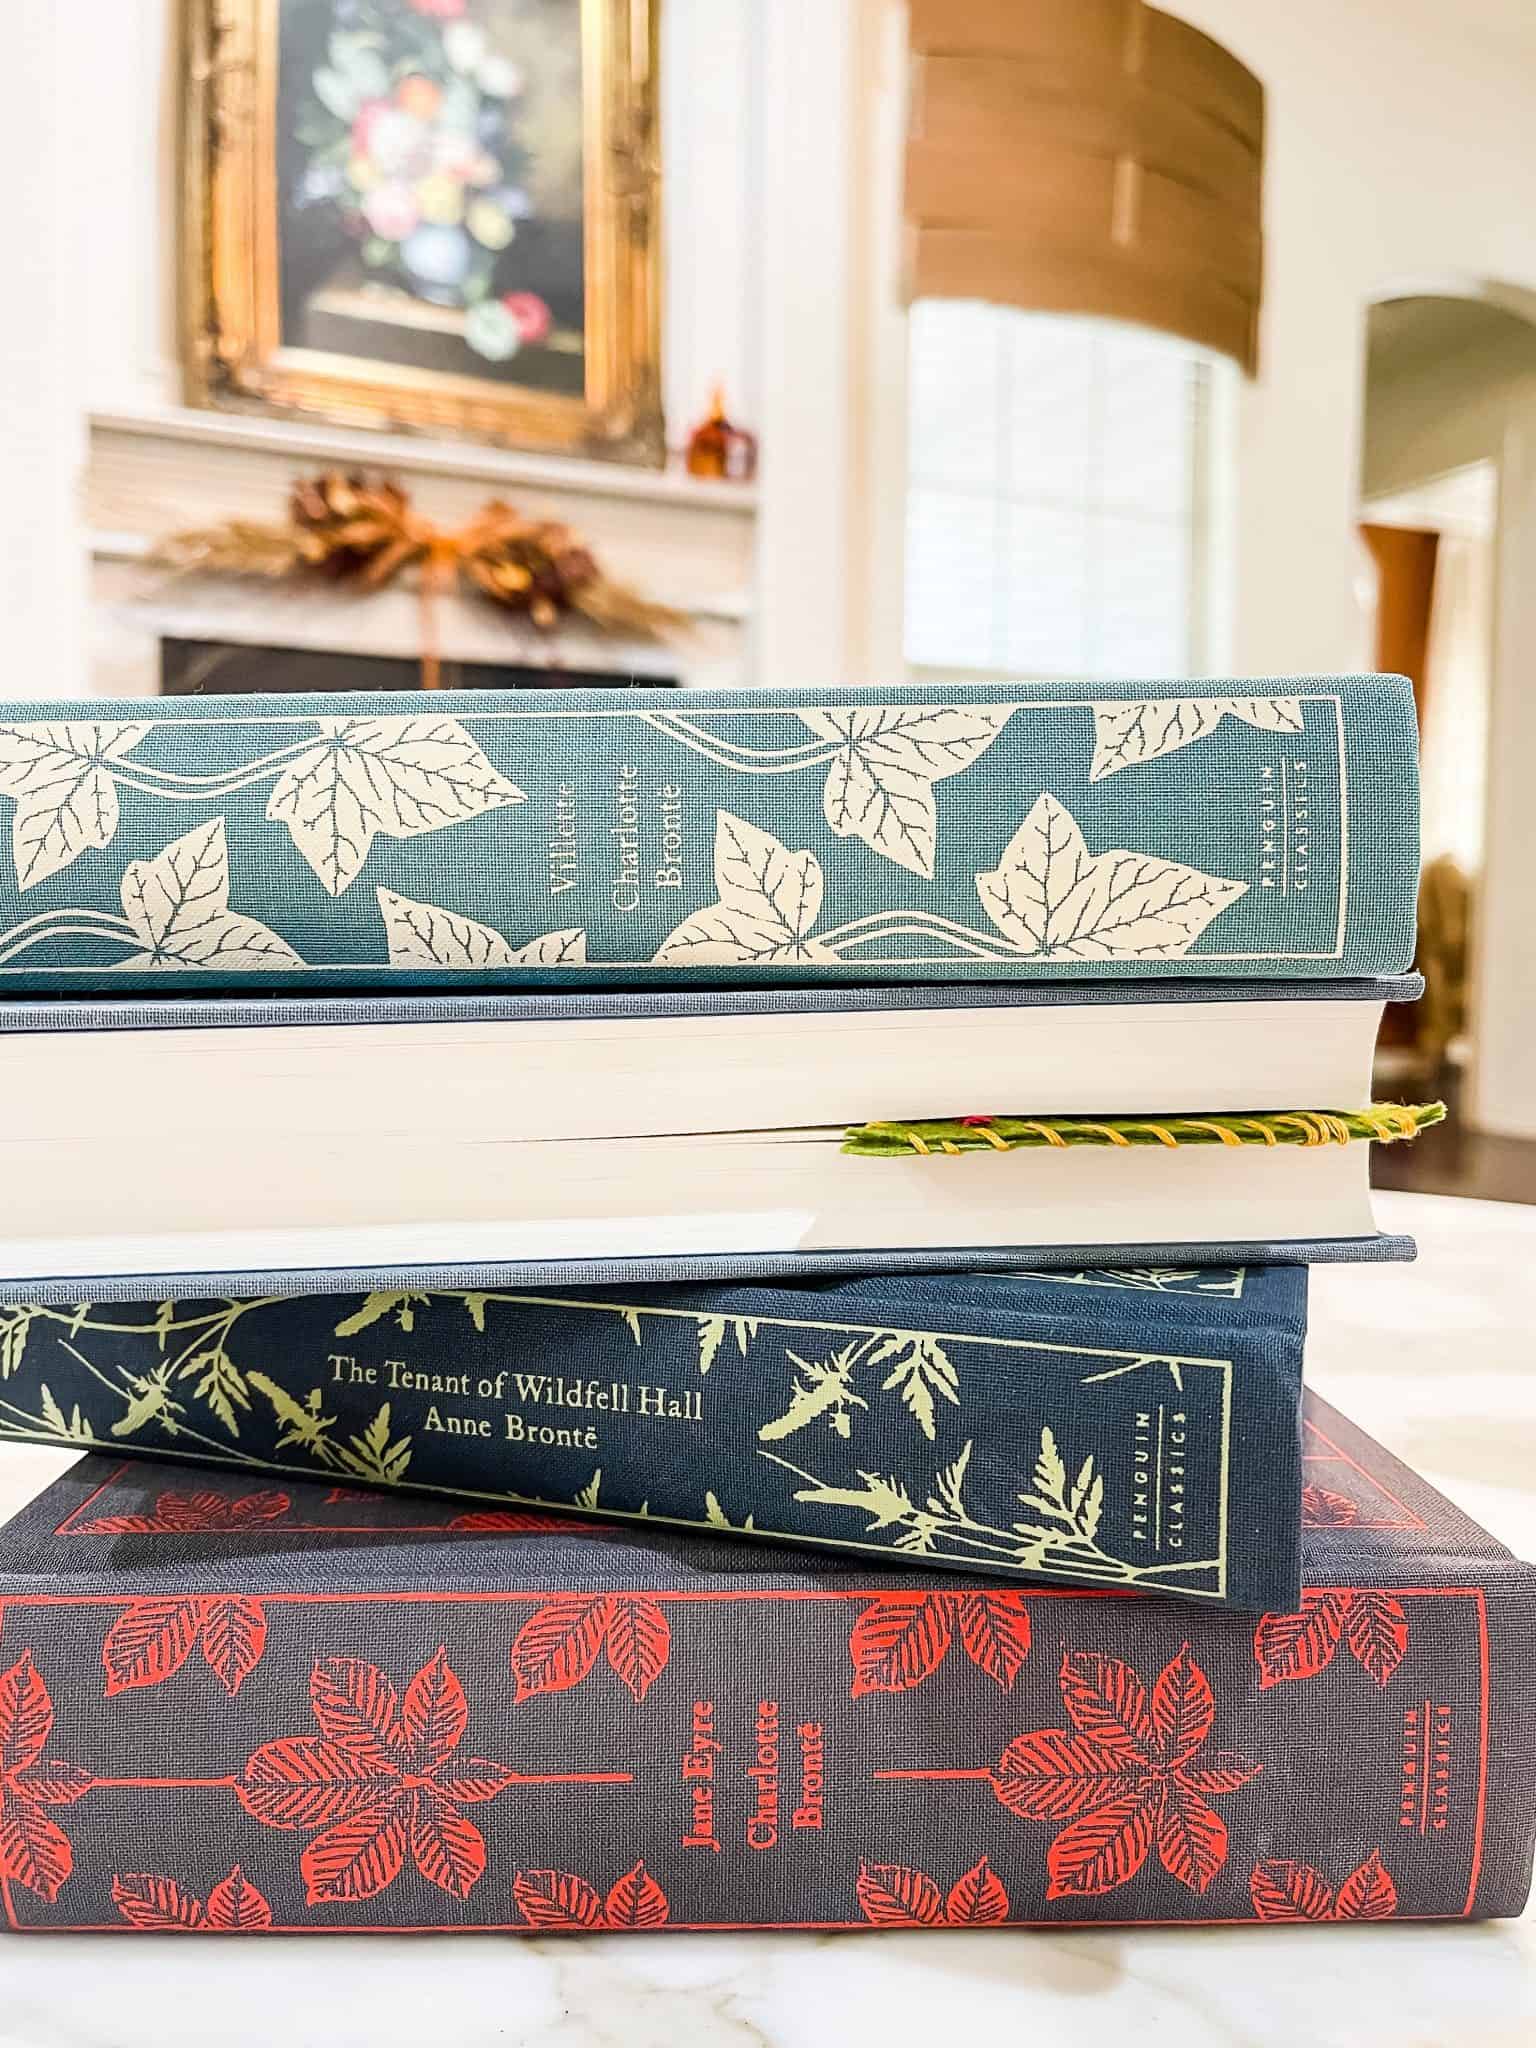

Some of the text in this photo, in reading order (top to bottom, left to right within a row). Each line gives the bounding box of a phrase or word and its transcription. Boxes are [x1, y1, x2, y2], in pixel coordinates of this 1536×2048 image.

[549, 781, 577, 897] Villette
[613, 766, 640, 911] Charlotte
[1261, 767, 1275, 887] PENGUIN
[1295, 761, 1308, 890] CLASSICS
[328, 1355, 704, 1420] The Tenant of Wildfell Hall
[424, 1406, 598, 1449] Anne Brontë
[1133, 1413, 1150, 1539] PENGUIN
[1168, 1413, 1186, 1547] CLASSICS
[681, 1701, 723, 1853] Jane Eyre
[747, 1701, 779, 1849] Charlotte
